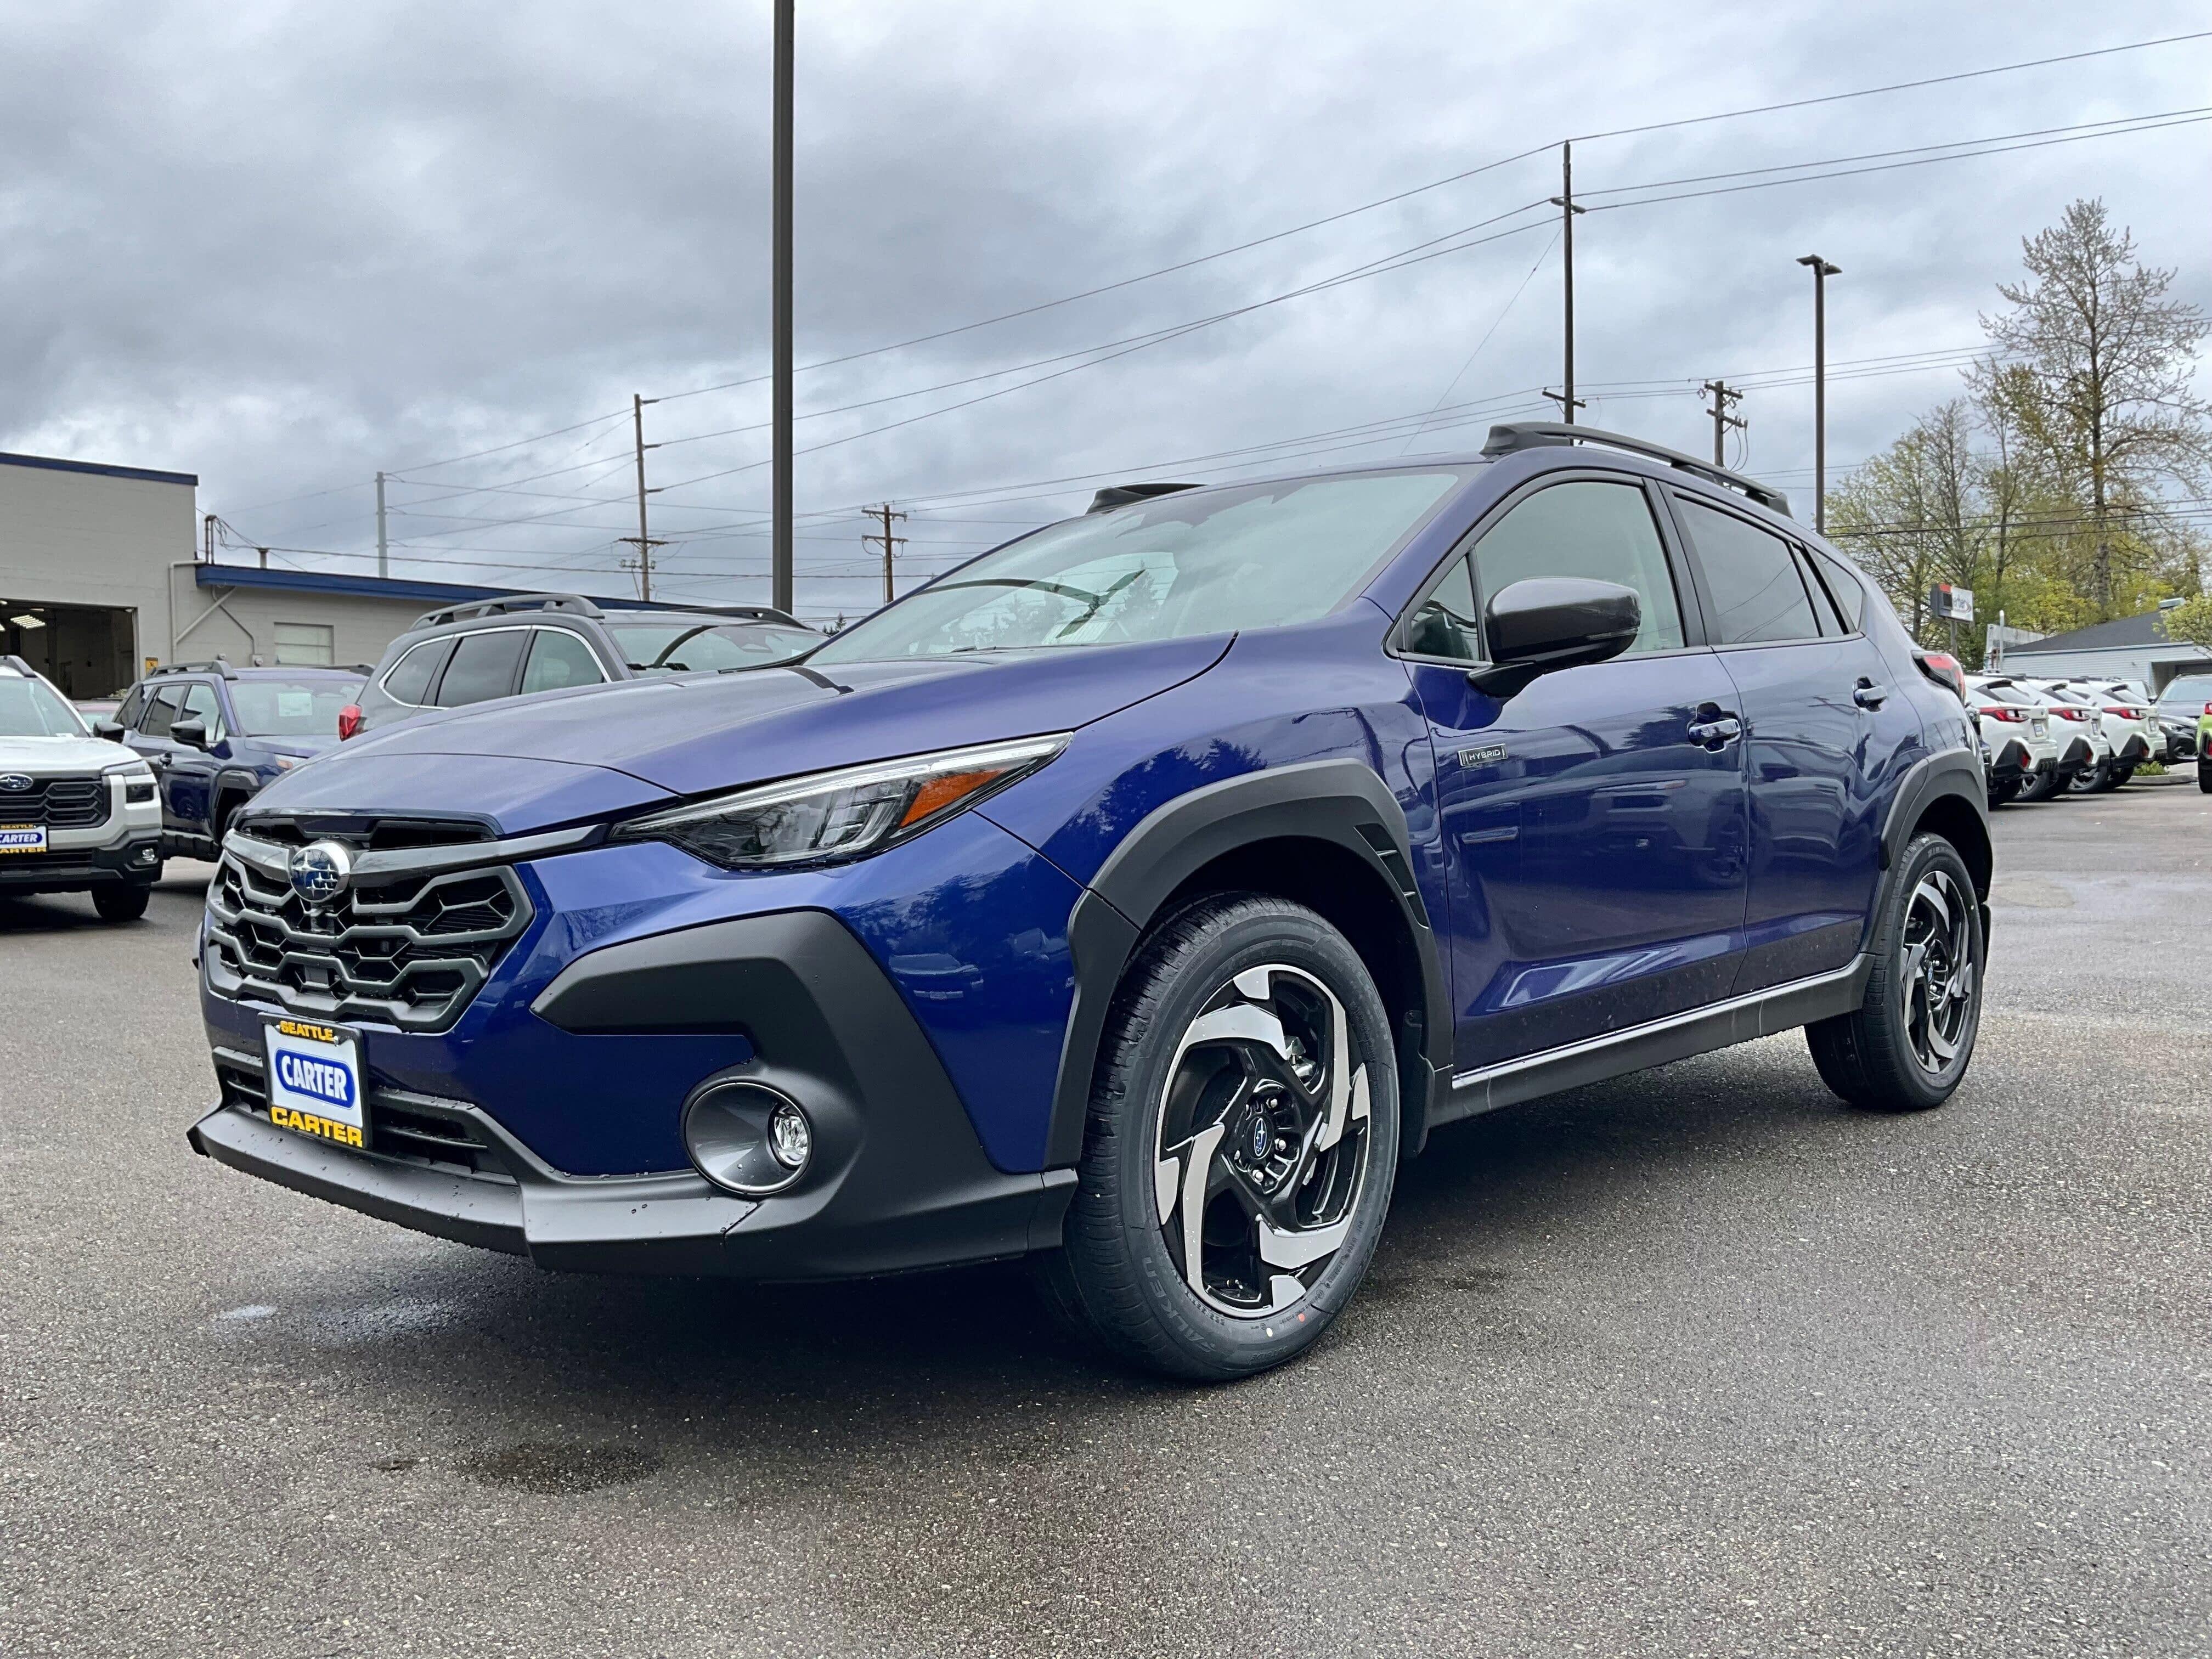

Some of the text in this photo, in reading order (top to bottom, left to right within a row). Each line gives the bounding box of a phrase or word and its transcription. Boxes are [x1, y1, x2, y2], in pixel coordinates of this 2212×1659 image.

[1469, 749, 1500, 760] HYBRID
[280, 1020, 335, 1041] SEATTLE
[281, 1055, 347, 1101] CARTER
[271, 1106, 363, 1148] CARTER
